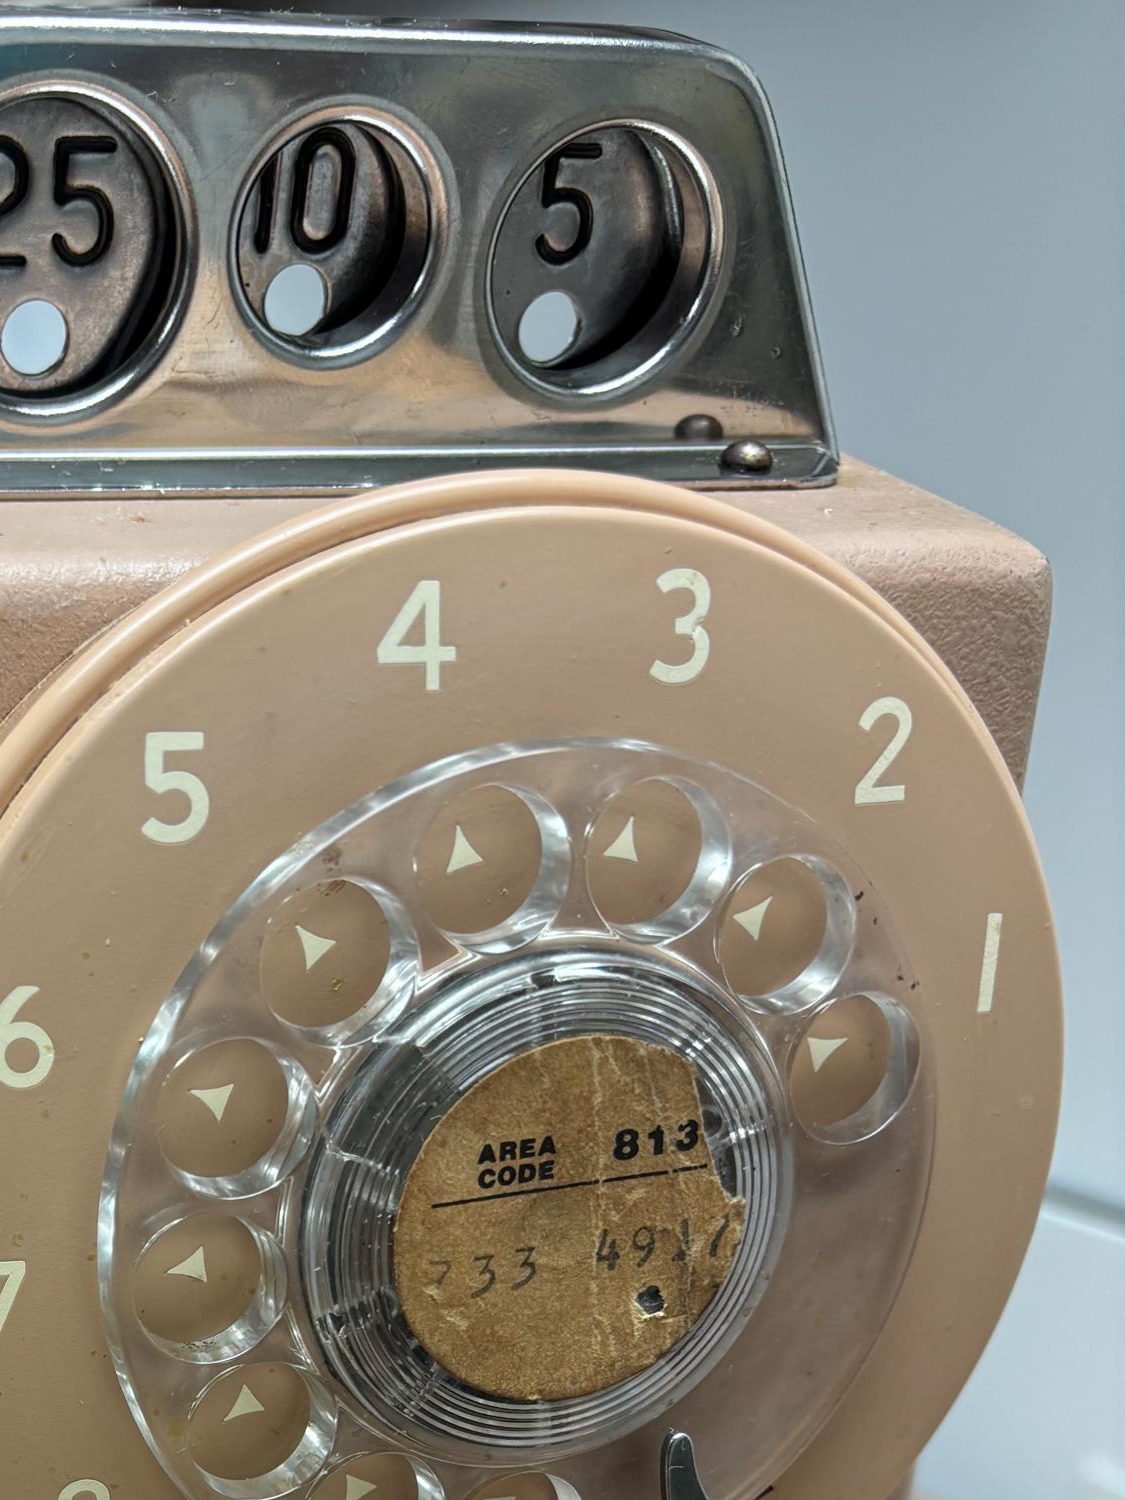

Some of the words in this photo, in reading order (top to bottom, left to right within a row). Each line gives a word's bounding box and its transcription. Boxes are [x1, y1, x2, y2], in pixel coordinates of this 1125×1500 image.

[253, 127, 357, 253] 10
[535, 142, 602, 265] 5
[377, 580, 457, 692] 4
[649, 568, 711, 684] 3
[141, 731, 210, 844] 5
[854, 697, 913, 805] 2
[977, 913, 1002, 1012] 1
[477, 1135, 556, 1164] AREA
[478, 1160, 555, 1189] CODE
[613, 1120, 699, 1160] 813
